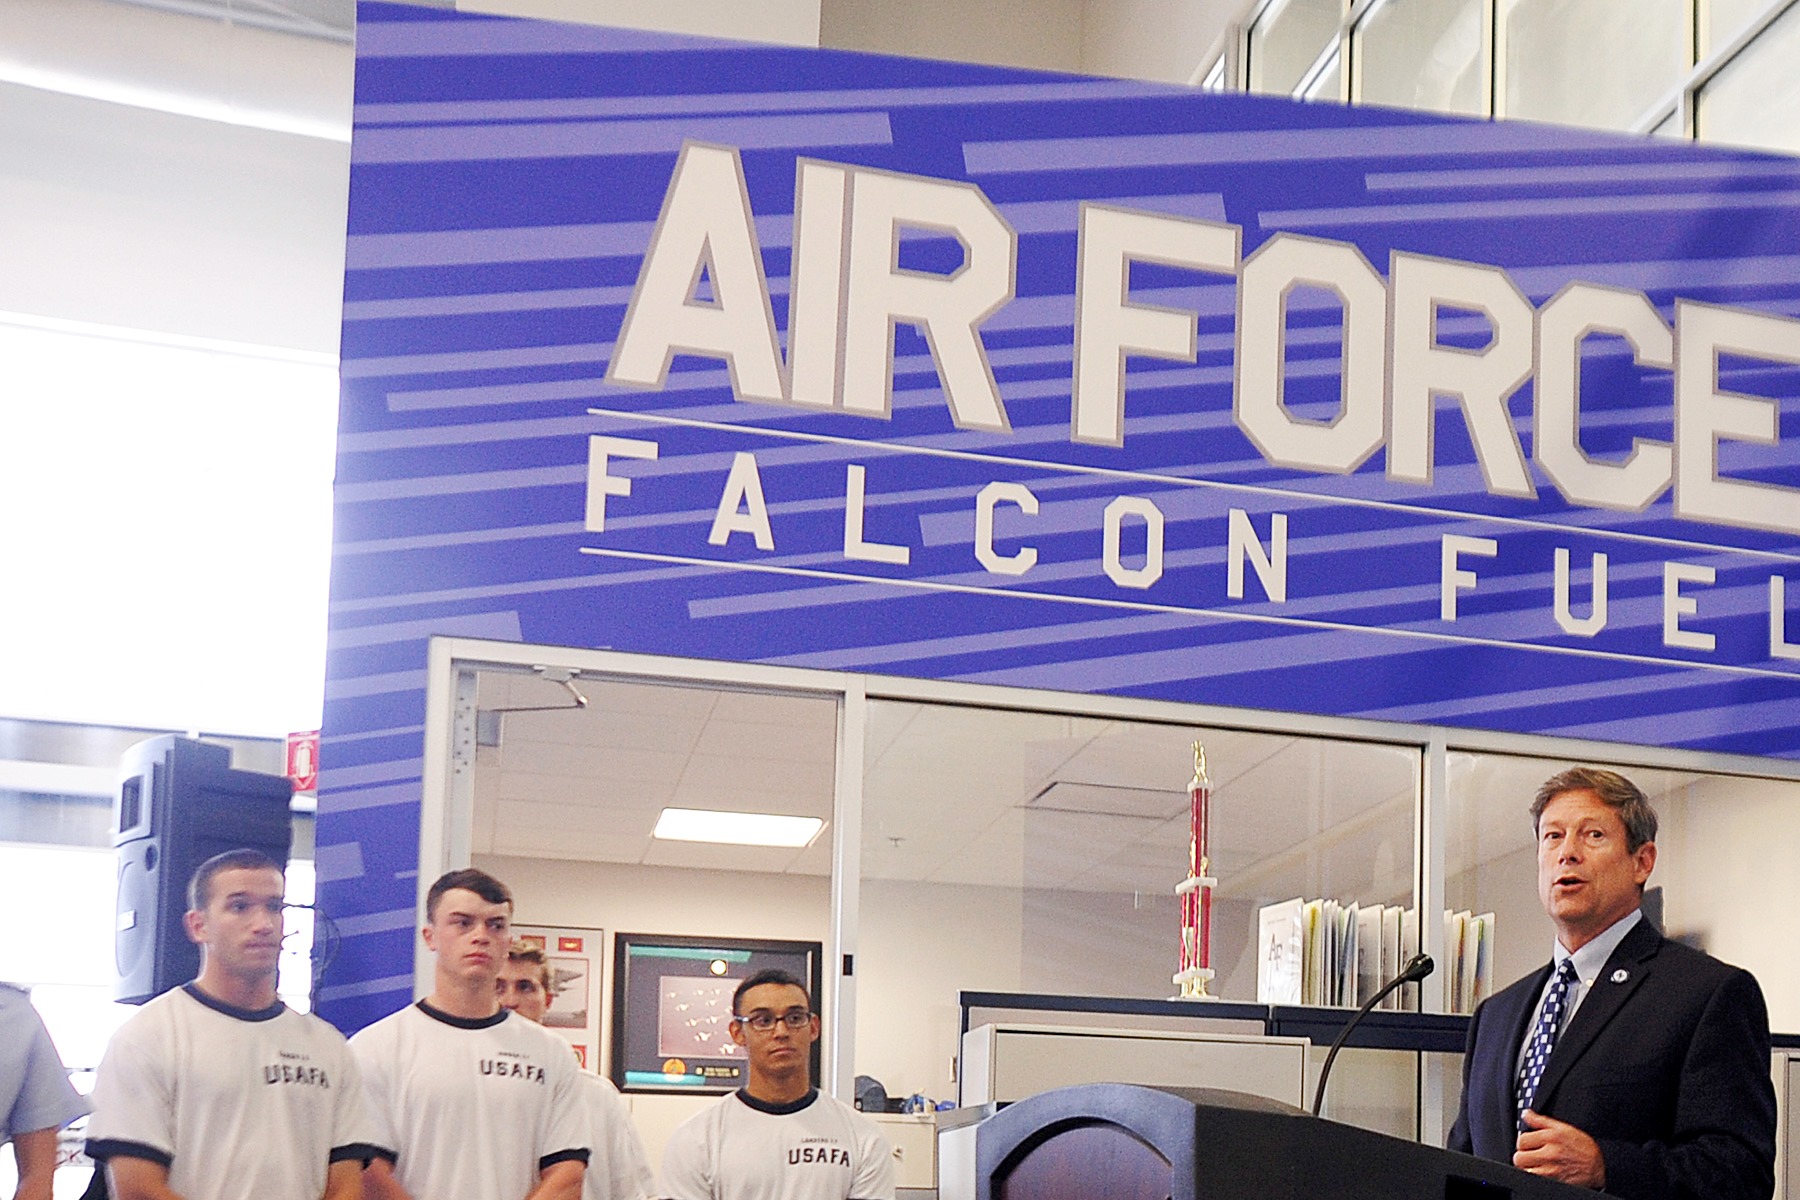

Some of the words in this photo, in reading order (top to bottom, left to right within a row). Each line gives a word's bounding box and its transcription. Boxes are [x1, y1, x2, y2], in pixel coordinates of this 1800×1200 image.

[604, 138, 1016, 434] AIR
[583, 435, 1289, 602] FALCON
[264, 1064, 330, 1089] USAFA
[480, 1059, 546, 1085] USAFA
[788, 1147, 850, 1167] USAFA
